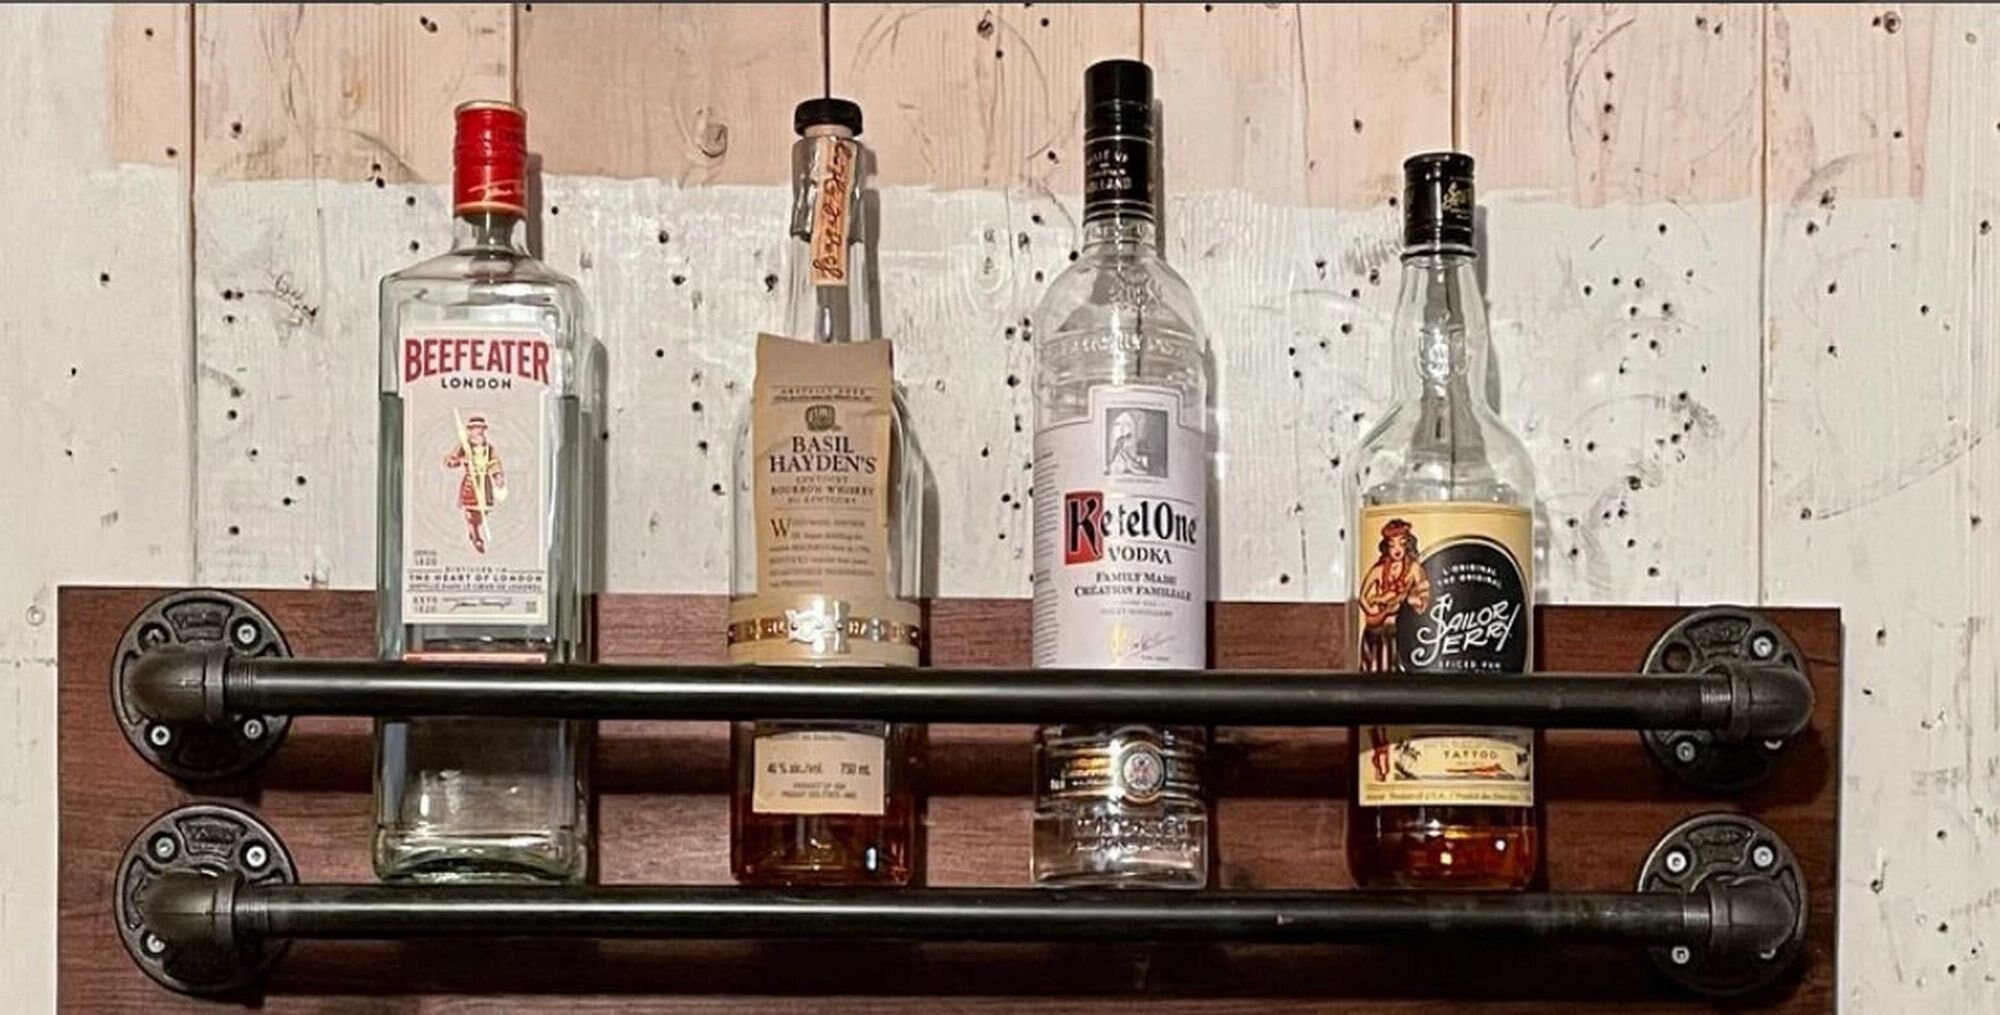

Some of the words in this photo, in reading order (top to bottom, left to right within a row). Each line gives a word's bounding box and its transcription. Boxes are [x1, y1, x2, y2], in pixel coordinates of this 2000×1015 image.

[404, 338, 550, 386] BEEFEATER
[441, 377, 513, 390] LONDON
[792, 434, 855, 454] BASIL
[769, 454, 877, 475] HAYDEN'S
[1069, 497, 1151, 558] Ketel
[1153, 501, 1198, 545] One
[1107, 546, 1173, 565] VODKA
[408, 574, 430, 582] THE
[434, 574, 472, 582] HEART
[474, 574, 490, 582] OF
[493, 574, 543, 583] LONDON
[1095, 571, 1142, 583] FAMILY
[1143, 572, 1178, 585] MADE
[1135, 586, 1193, 601] FAMILIALE
[1442, 749, 1498, 760] TATTOO
